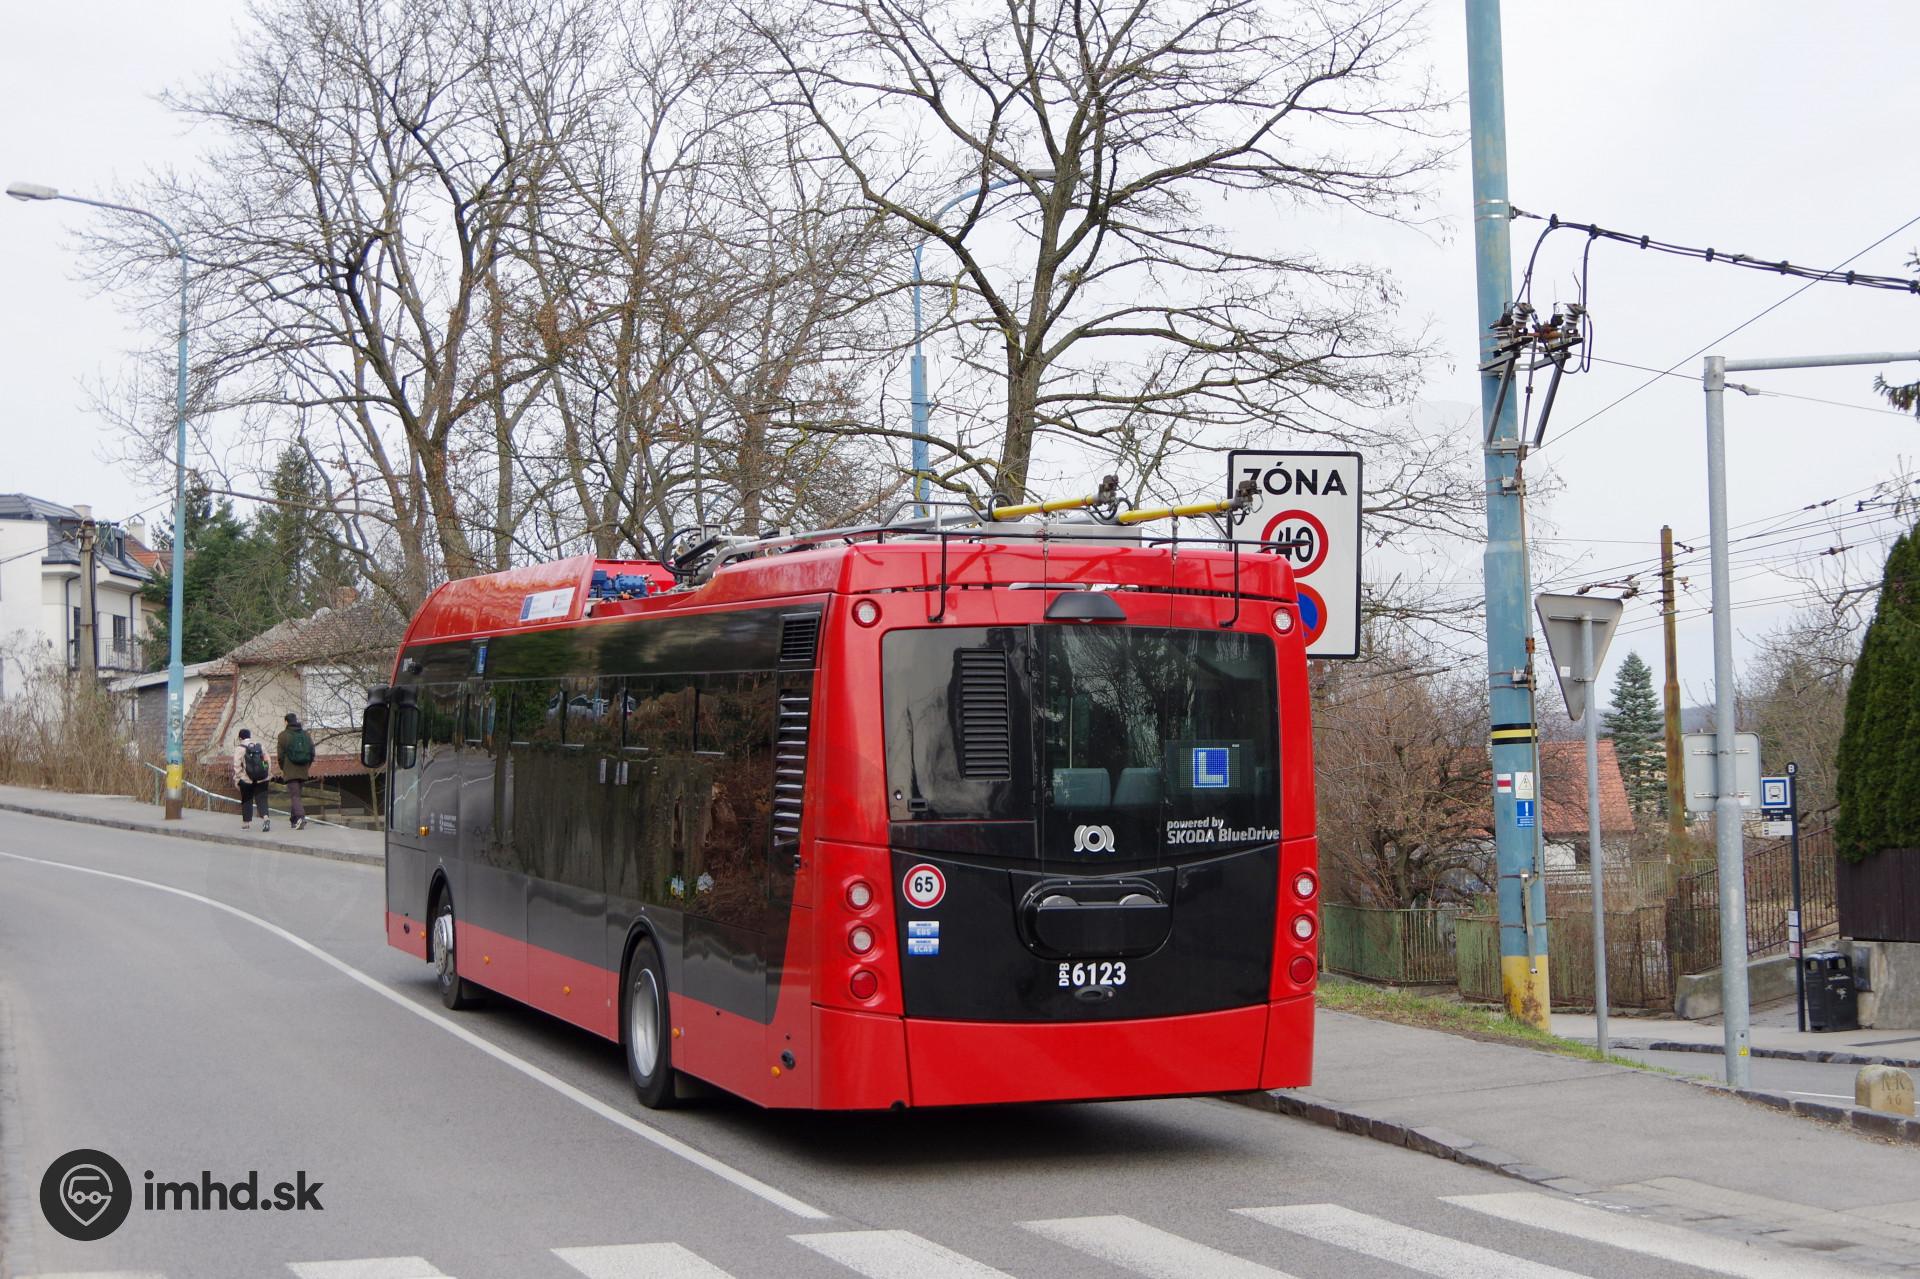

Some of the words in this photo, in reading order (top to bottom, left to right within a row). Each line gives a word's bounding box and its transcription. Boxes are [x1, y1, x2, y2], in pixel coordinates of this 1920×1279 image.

[1243, 461, 1348, 496] ZÓNA
[1276, 526, 1314, 563] 40
[1166, 817, 1210, 831] powered
[1211, 817, 1224, 830] by
[1218, 826, 1280, 842] BlueDrive
[914, 876, 934, 893] 65
[1059, 963, 1070, 986] DPB
[1072, 962, 1126, 986] 6123
